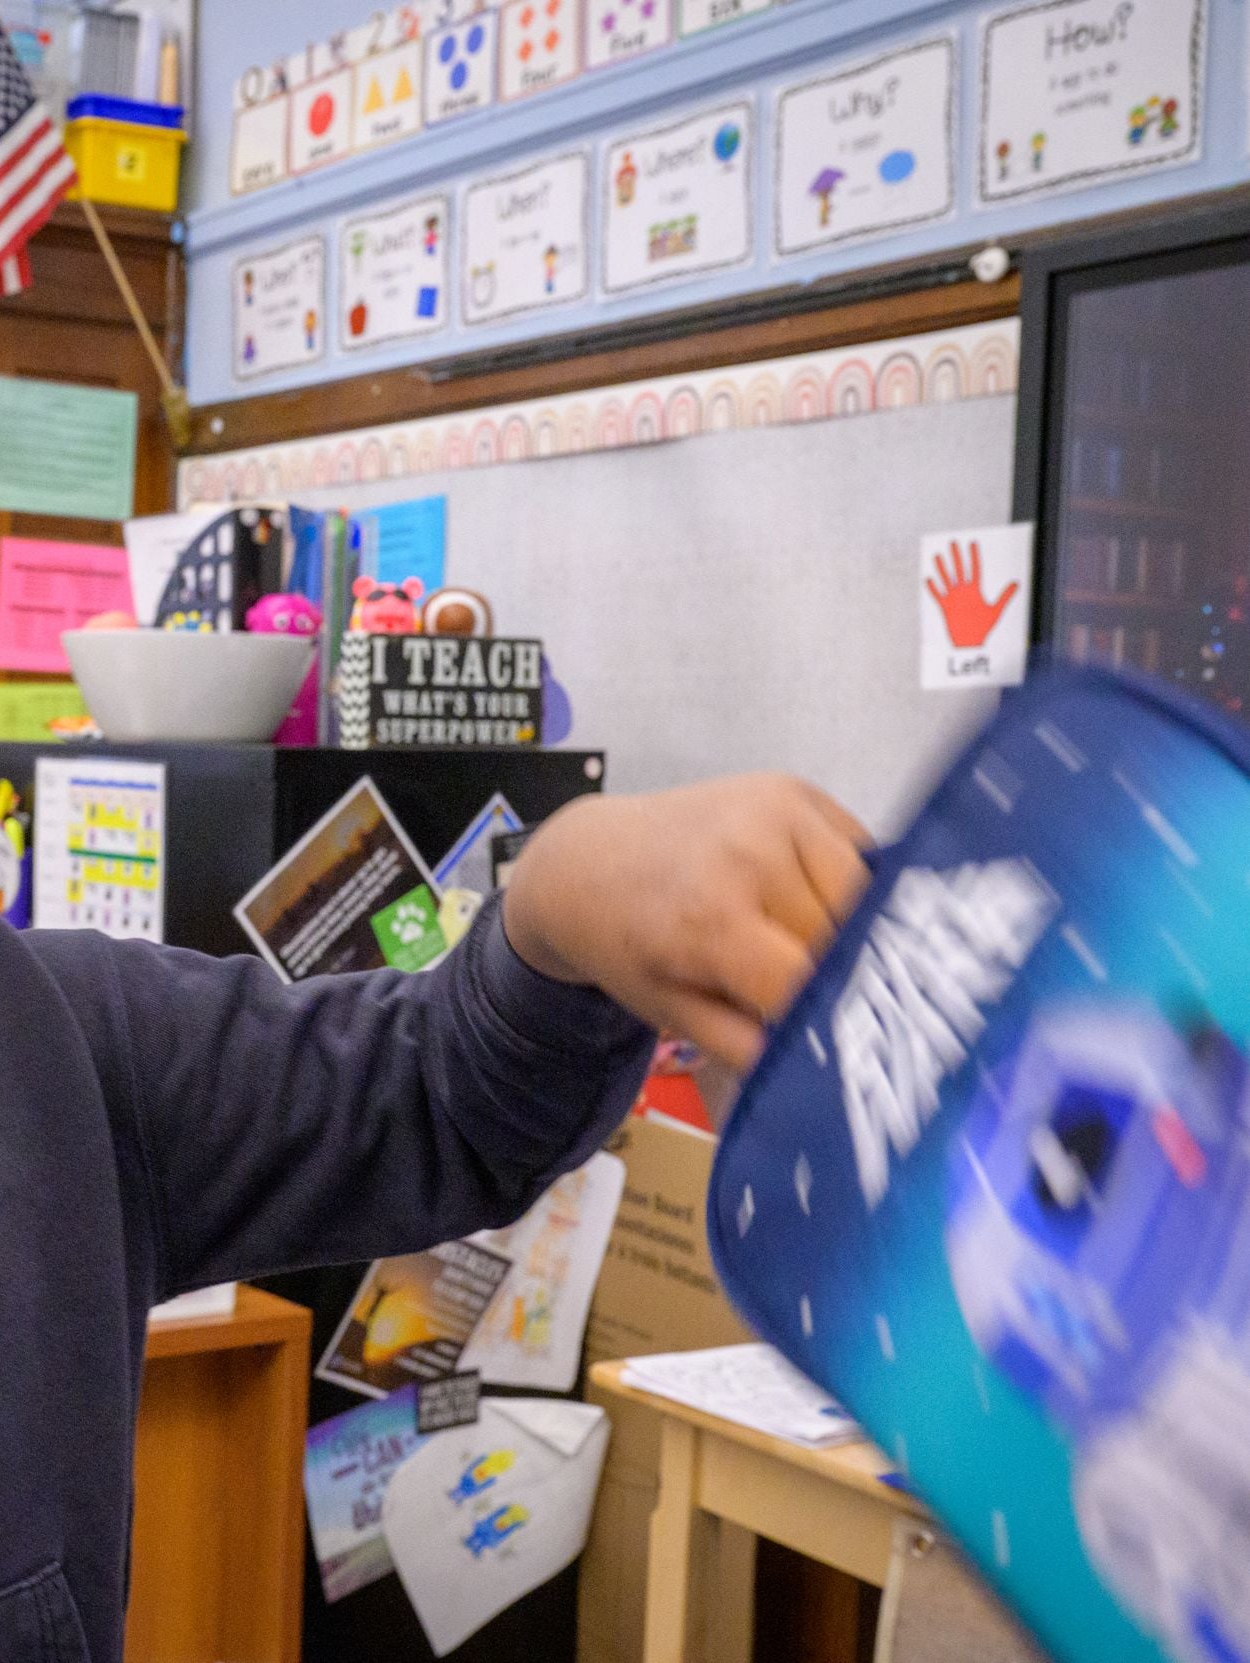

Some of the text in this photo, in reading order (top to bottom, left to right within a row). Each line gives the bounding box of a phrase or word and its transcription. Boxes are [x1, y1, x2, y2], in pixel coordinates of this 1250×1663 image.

[1044, 2, 1135, 62] How?
[828, 77, 899, 125] Why?
[372, 637, 542, 689] I TEACH
[948, 656, 991, 676] Left
[383, 689, 530, 718] WHAT'S YOUR
